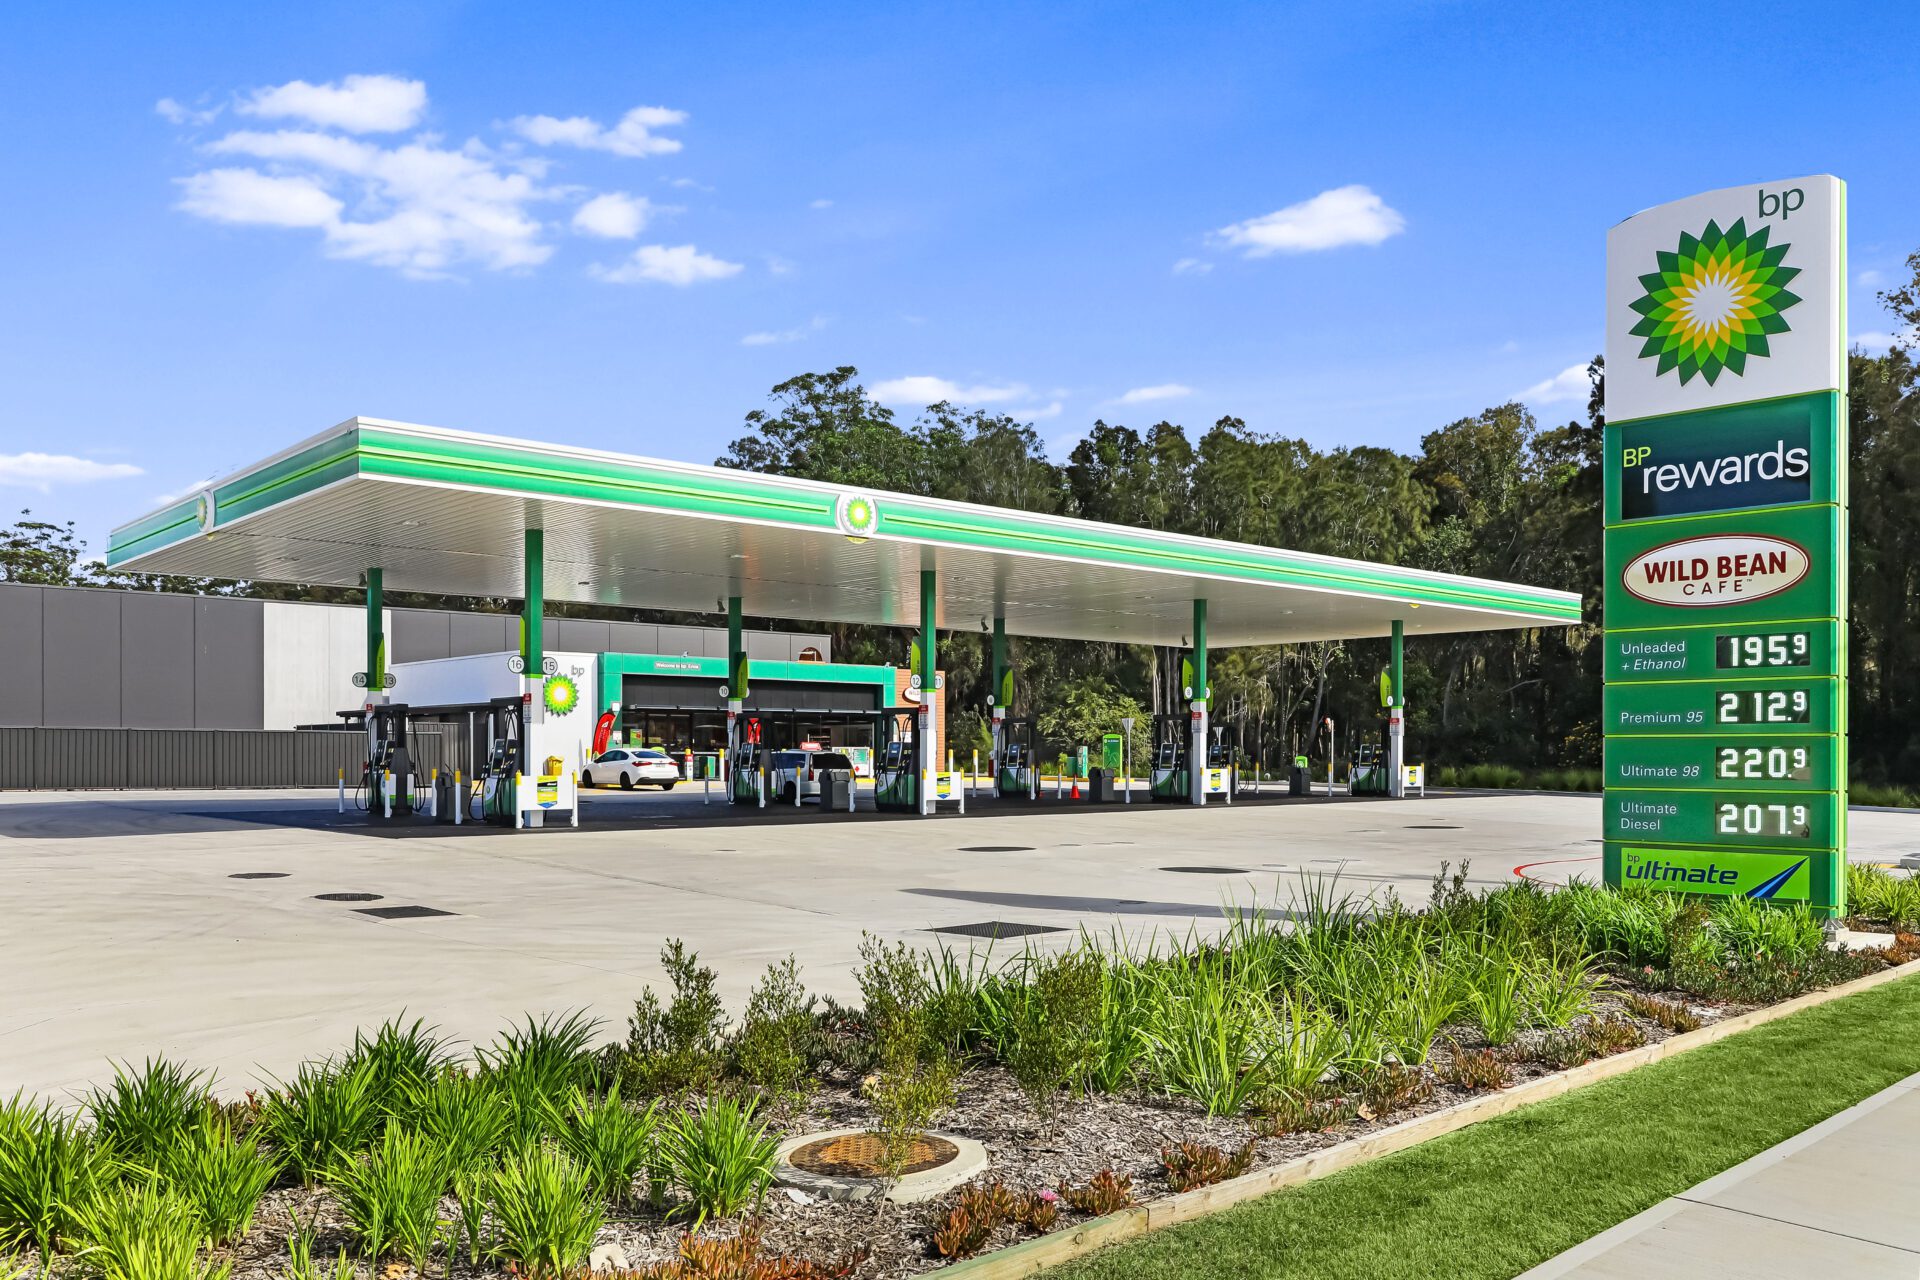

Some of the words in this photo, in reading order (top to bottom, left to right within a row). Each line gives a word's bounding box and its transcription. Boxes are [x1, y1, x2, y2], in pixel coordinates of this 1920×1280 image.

[1758, 188, 1805, 220] bp
[1623, 446, 1651, 468] BP
[1643, 440, 1810, 494] rewards
[1643, 558, 1709, 584] WILD
[1717, 551, 1787, 579] BEAN
[1682, 579, 1743, 596] CAFE
[1621, 640, 1685, 655] Unleaded
[510, 659, 522, 670] 16
[544, 661, 555, 671] 15
[1633, 657, 1686, 671] Ethanol
[571, 665, 585, 678] bp
[354, 675, 365, 684] 14
[384, 676, 394, 685] 13
[912, 677, 920, 686] 12
[720, 687, 728, 696] 10
[1621, 712, 1681, 724] Premium
[1686, 711, 1704, 724] 95
[1621, 765, 1678, 777] Ultimate
[1682, 765, 1700, 777] 98
[1620, 801, 1677, 815] Ultimate
[1620, 818, 1661, 831] Diesel
[1627, 853, 1640, 864] bp
[1625, 860, 1739, 885] ultimate
